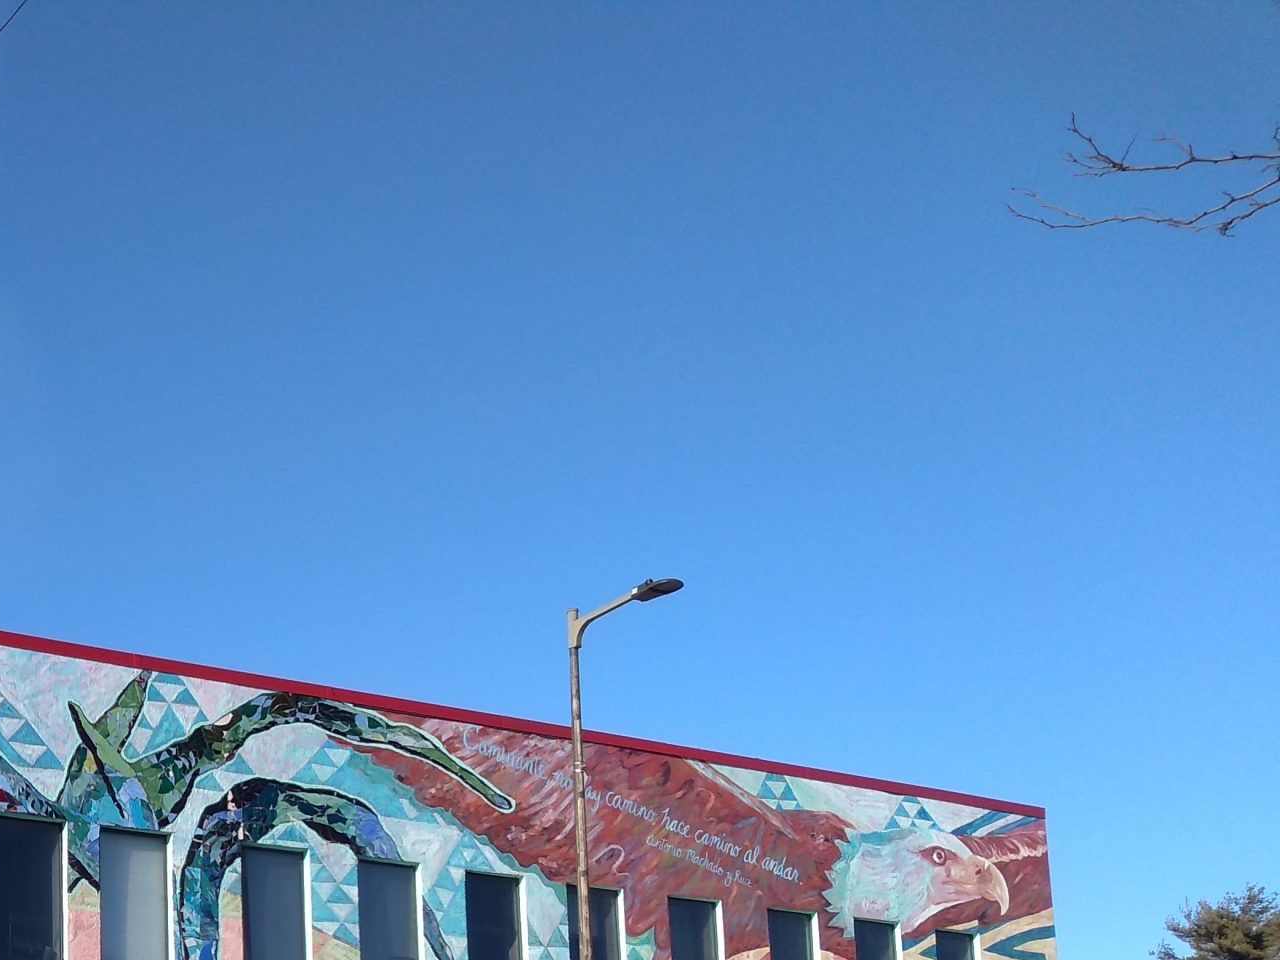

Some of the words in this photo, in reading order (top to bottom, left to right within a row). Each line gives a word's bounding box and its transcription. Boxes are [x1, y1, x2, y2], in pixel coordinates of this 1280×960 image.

[661, 807, 691, 838] hace
[694, 829, 742, 857] camino
[743, 846, 764, 867] al
